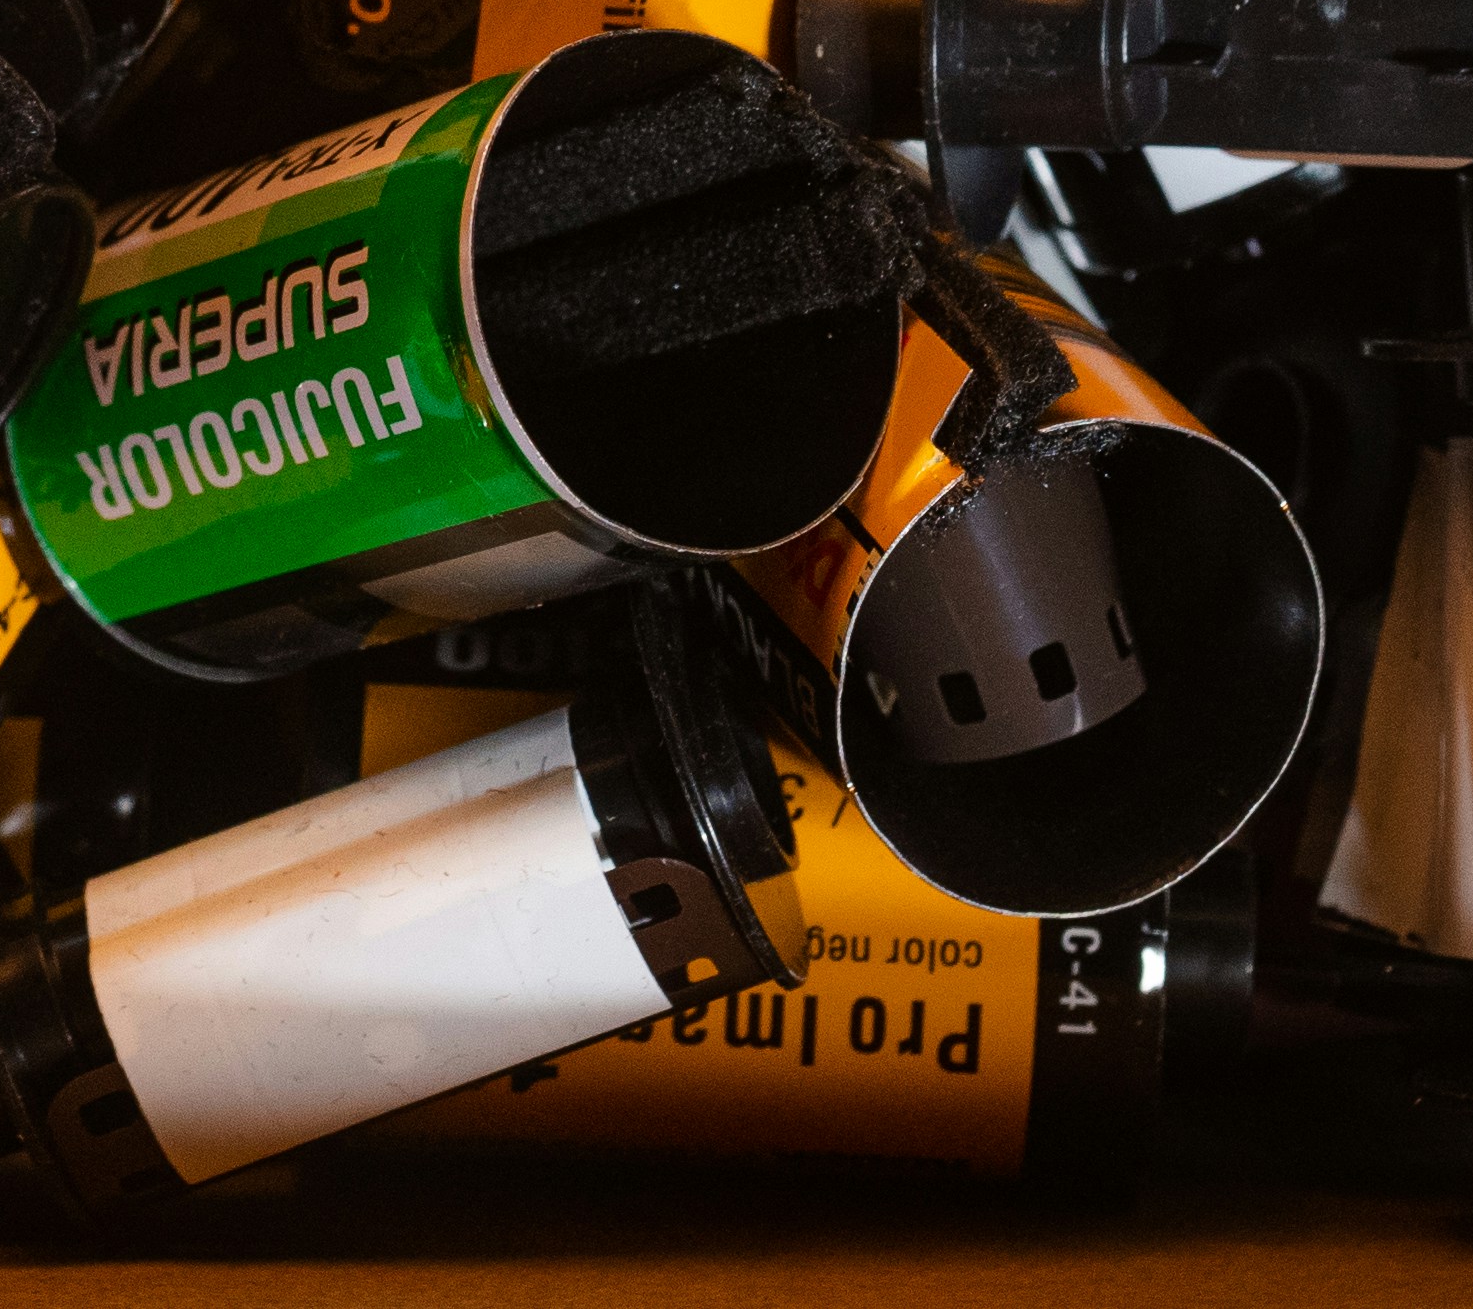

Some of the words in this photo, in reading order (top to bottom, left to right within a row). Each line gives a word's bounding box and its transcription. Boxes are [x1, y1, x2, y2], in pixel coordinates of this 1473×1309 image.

[81, 238, 372, 408] SUPERIA
[76, 353, 425, 523] FUJICOLOR
[882, 934, 983, 970] color
[1056, 923, 1102, 1045] C-41
[631, 992, 817, 1067] Ima
[852, 995, 983, 1074] Pro
